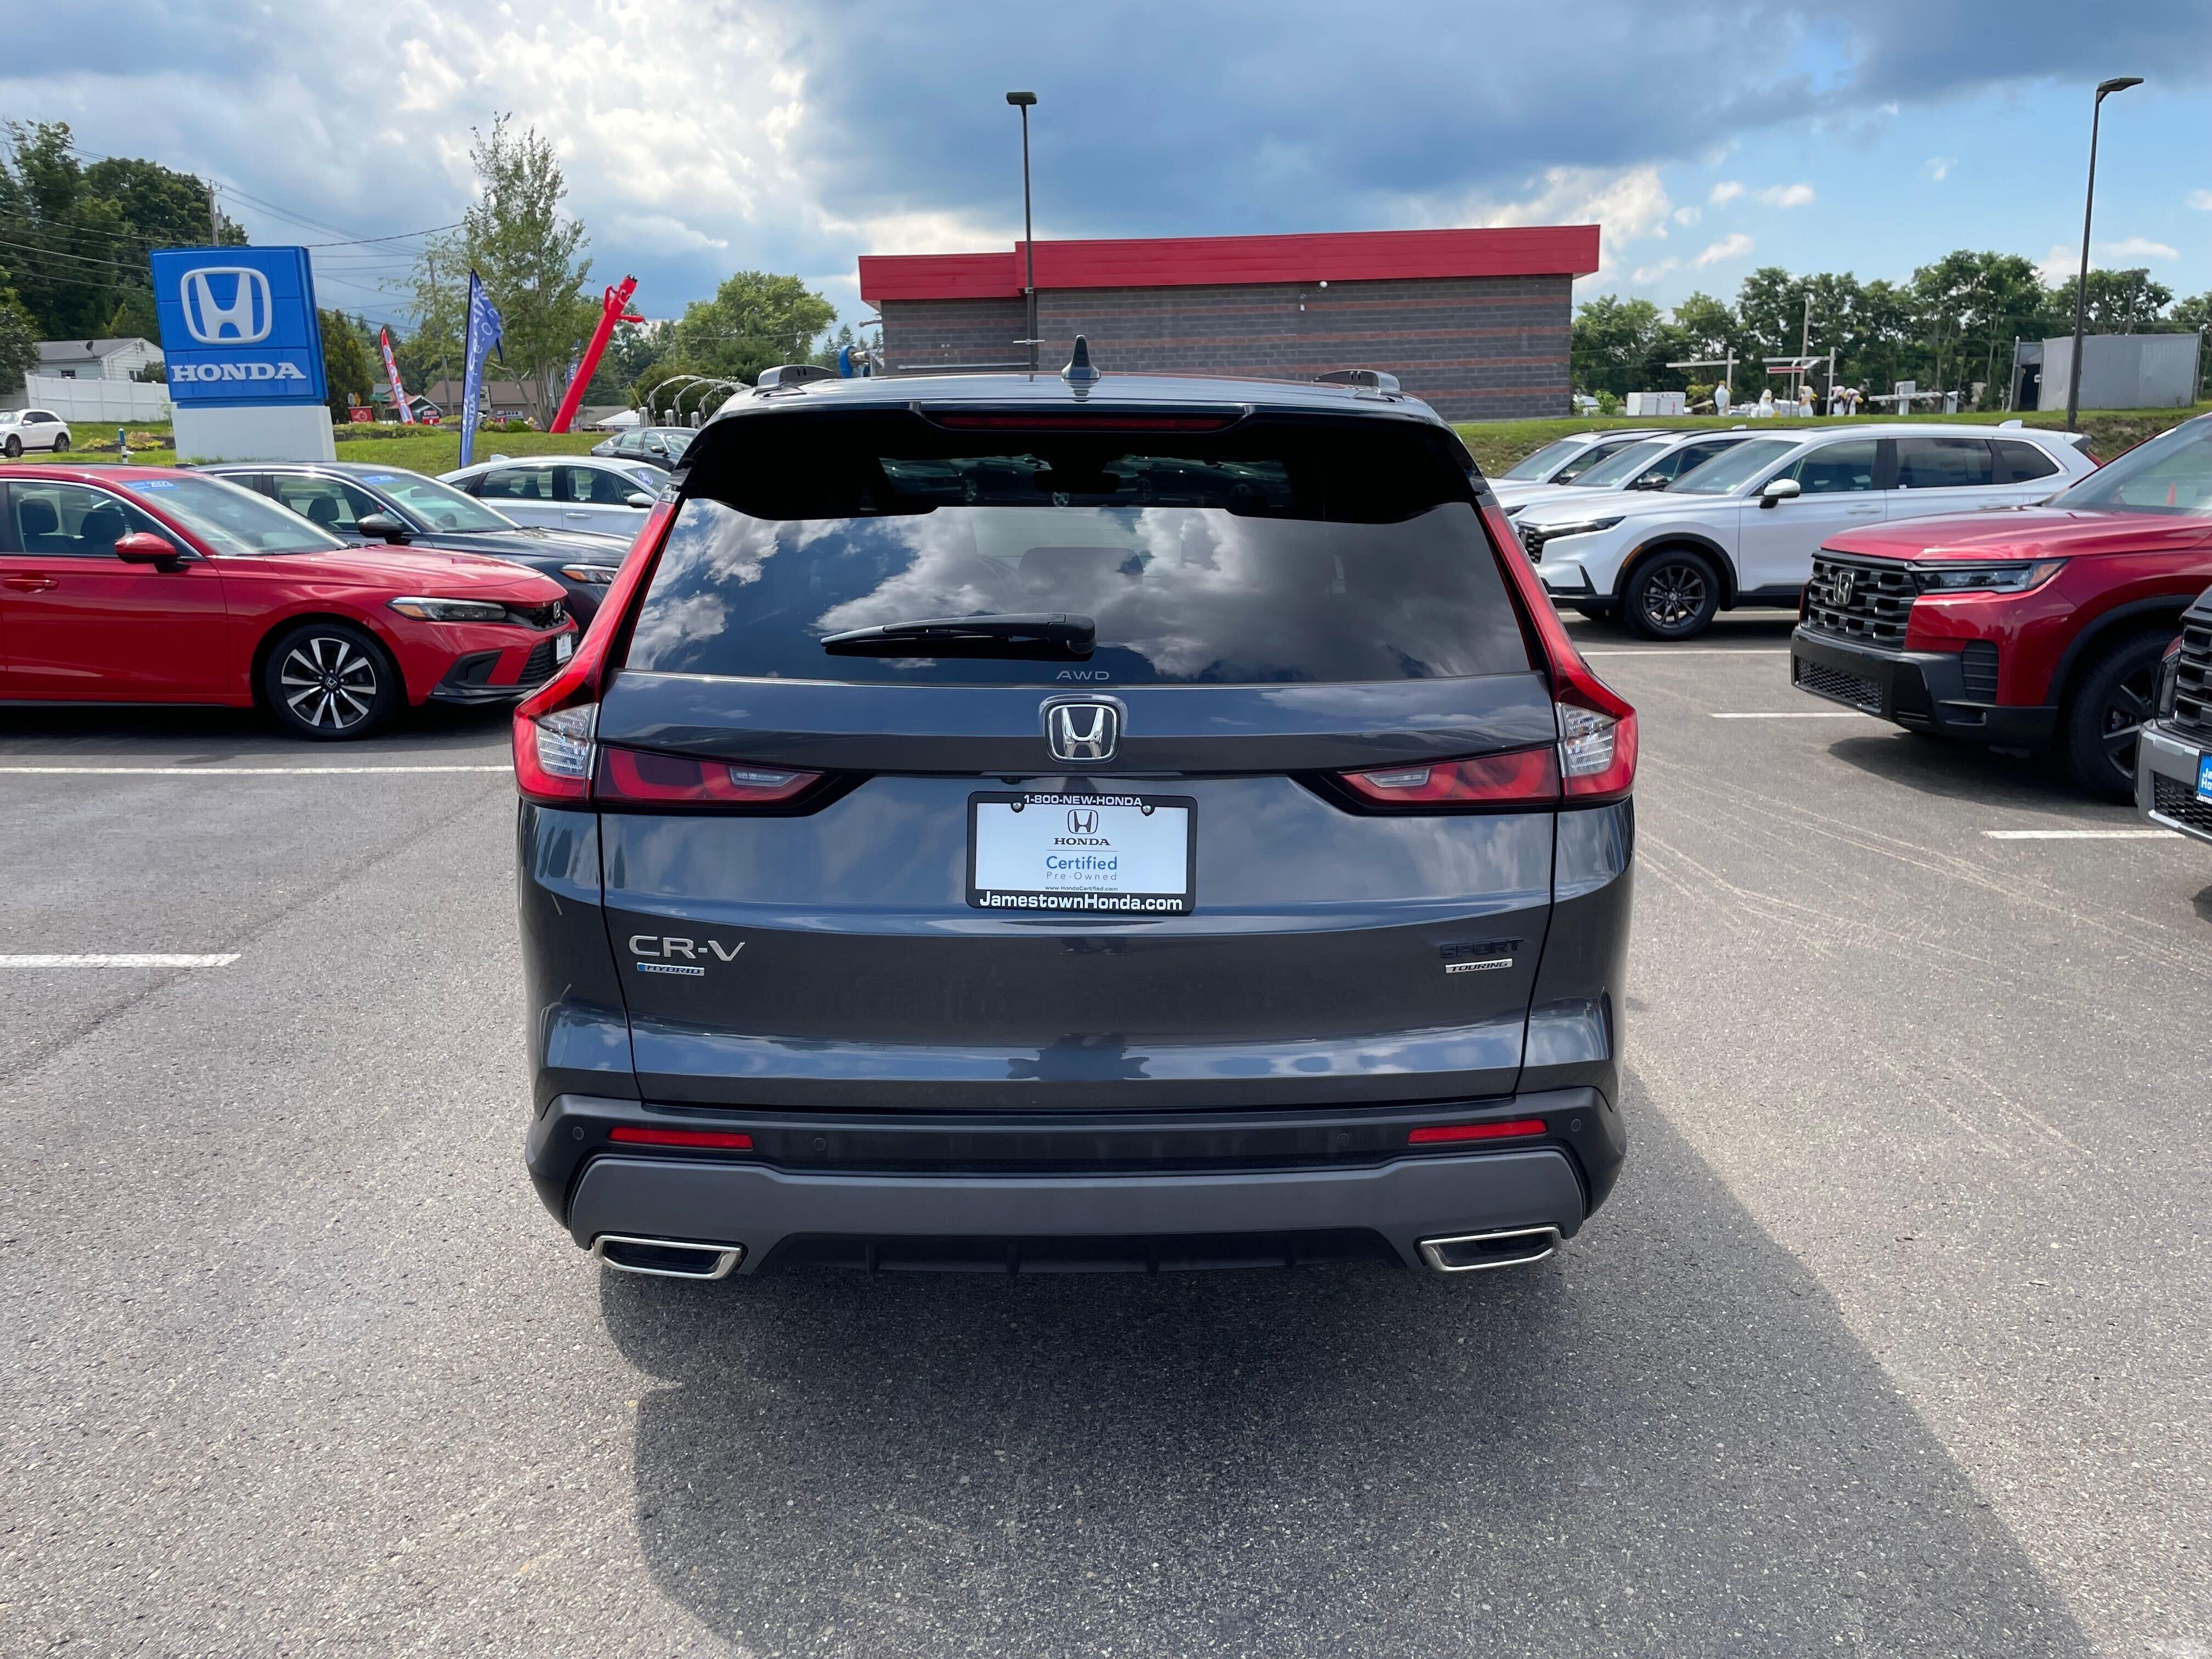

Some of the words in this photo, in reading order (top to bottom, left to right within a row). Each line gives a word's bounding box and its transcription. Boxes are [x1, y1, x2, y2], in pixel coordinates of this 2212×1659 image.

[171, 362, 306, 382] HONDA
[1056, 670, 1110, 680] AWD
[1024, 794, 1143, 806] 1-800-NEW-HONDA
[1053, 837, 1111, 846] HONDA
[1046, 855, 1118, 870] Certified
[1046, 871, 1117, 881] Pre-Owned
[979, 890, 1183, 911] JamestownHonda.com
[629, 935, 746, 961] CR-V
[1440, 937, 1524, 959] SPORT
[646, 964, 701, 975] HYBRID
[1451, 961, 1508, 972] TOURING
